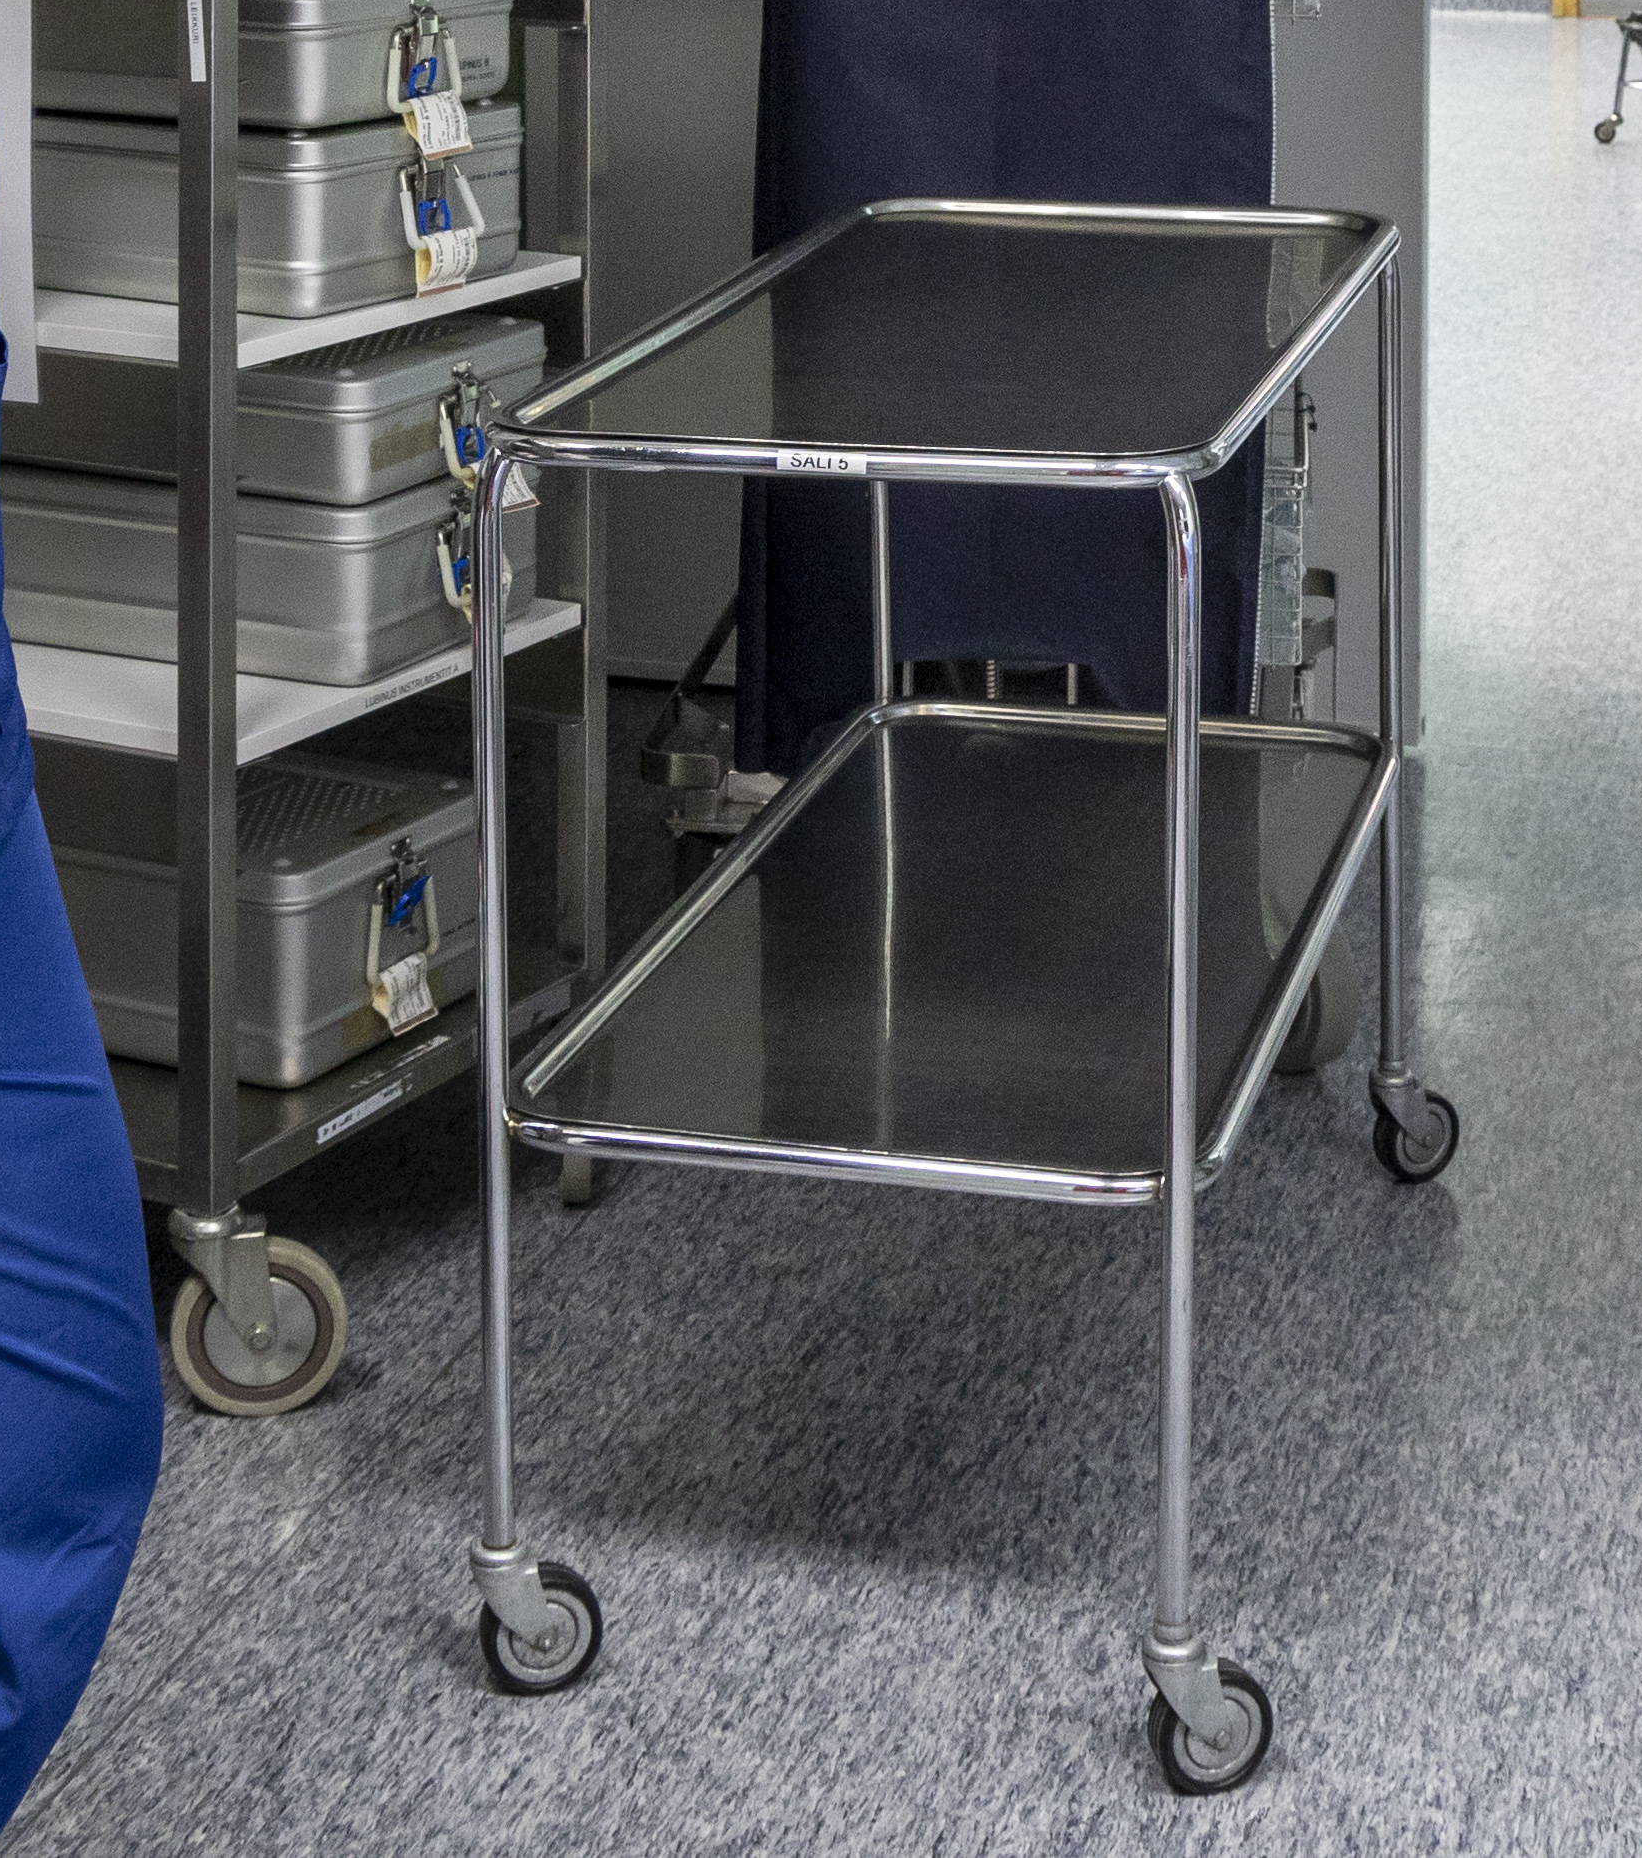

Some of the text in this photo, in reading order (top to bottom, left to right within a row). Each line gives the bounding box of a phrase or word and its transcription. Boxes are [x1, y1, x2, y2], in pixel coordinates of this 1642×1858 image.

[190, 1, 200, 44] LEIKKURI
[790, 453, 849, 471] SALI 5
[364, 664, 459, 709] LUBINUS INSTRUMENTIT A
